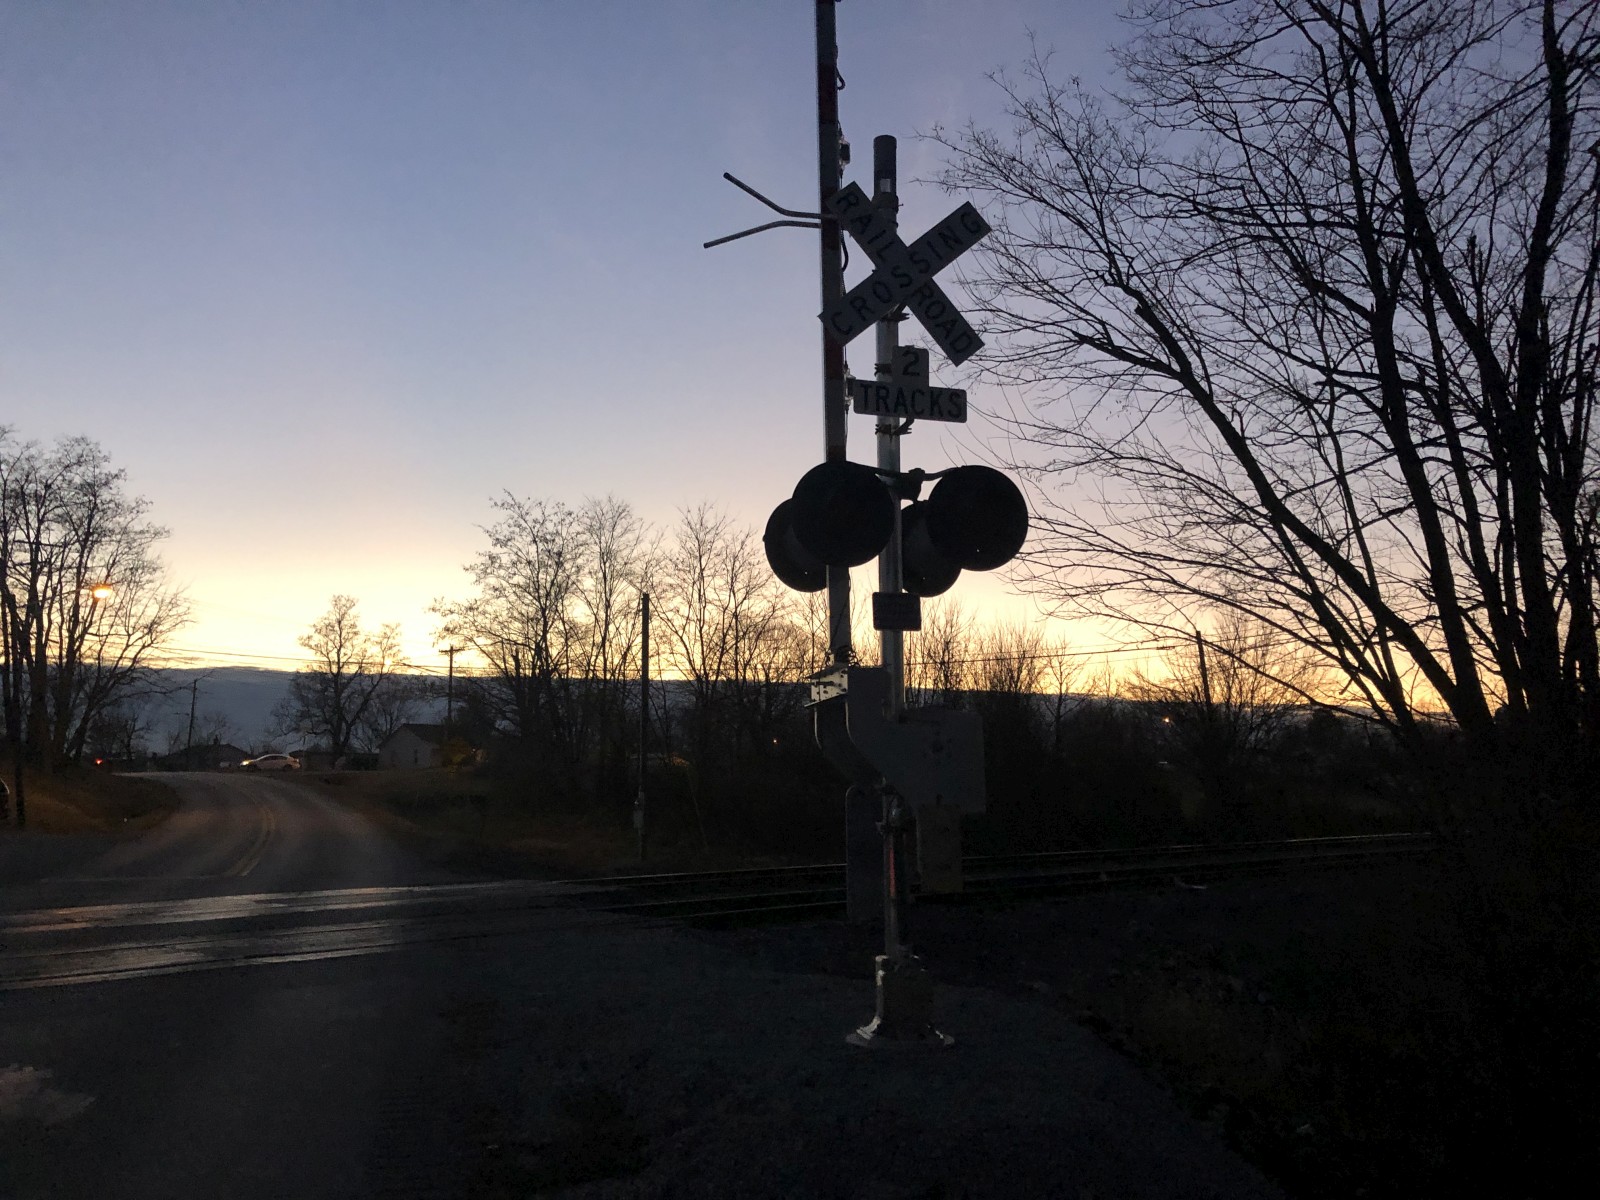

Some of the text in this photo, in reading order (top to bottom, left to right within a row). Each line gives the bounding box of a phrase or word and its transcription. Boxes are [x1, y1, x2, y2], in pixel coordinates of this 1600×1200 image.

[831, 211, 982, 335] CROSSING
[836, 193, 973, 354] RAIL ROAD
[860, 383, 962, 418] TRACKS
[902, 350, 921, 377] 2
